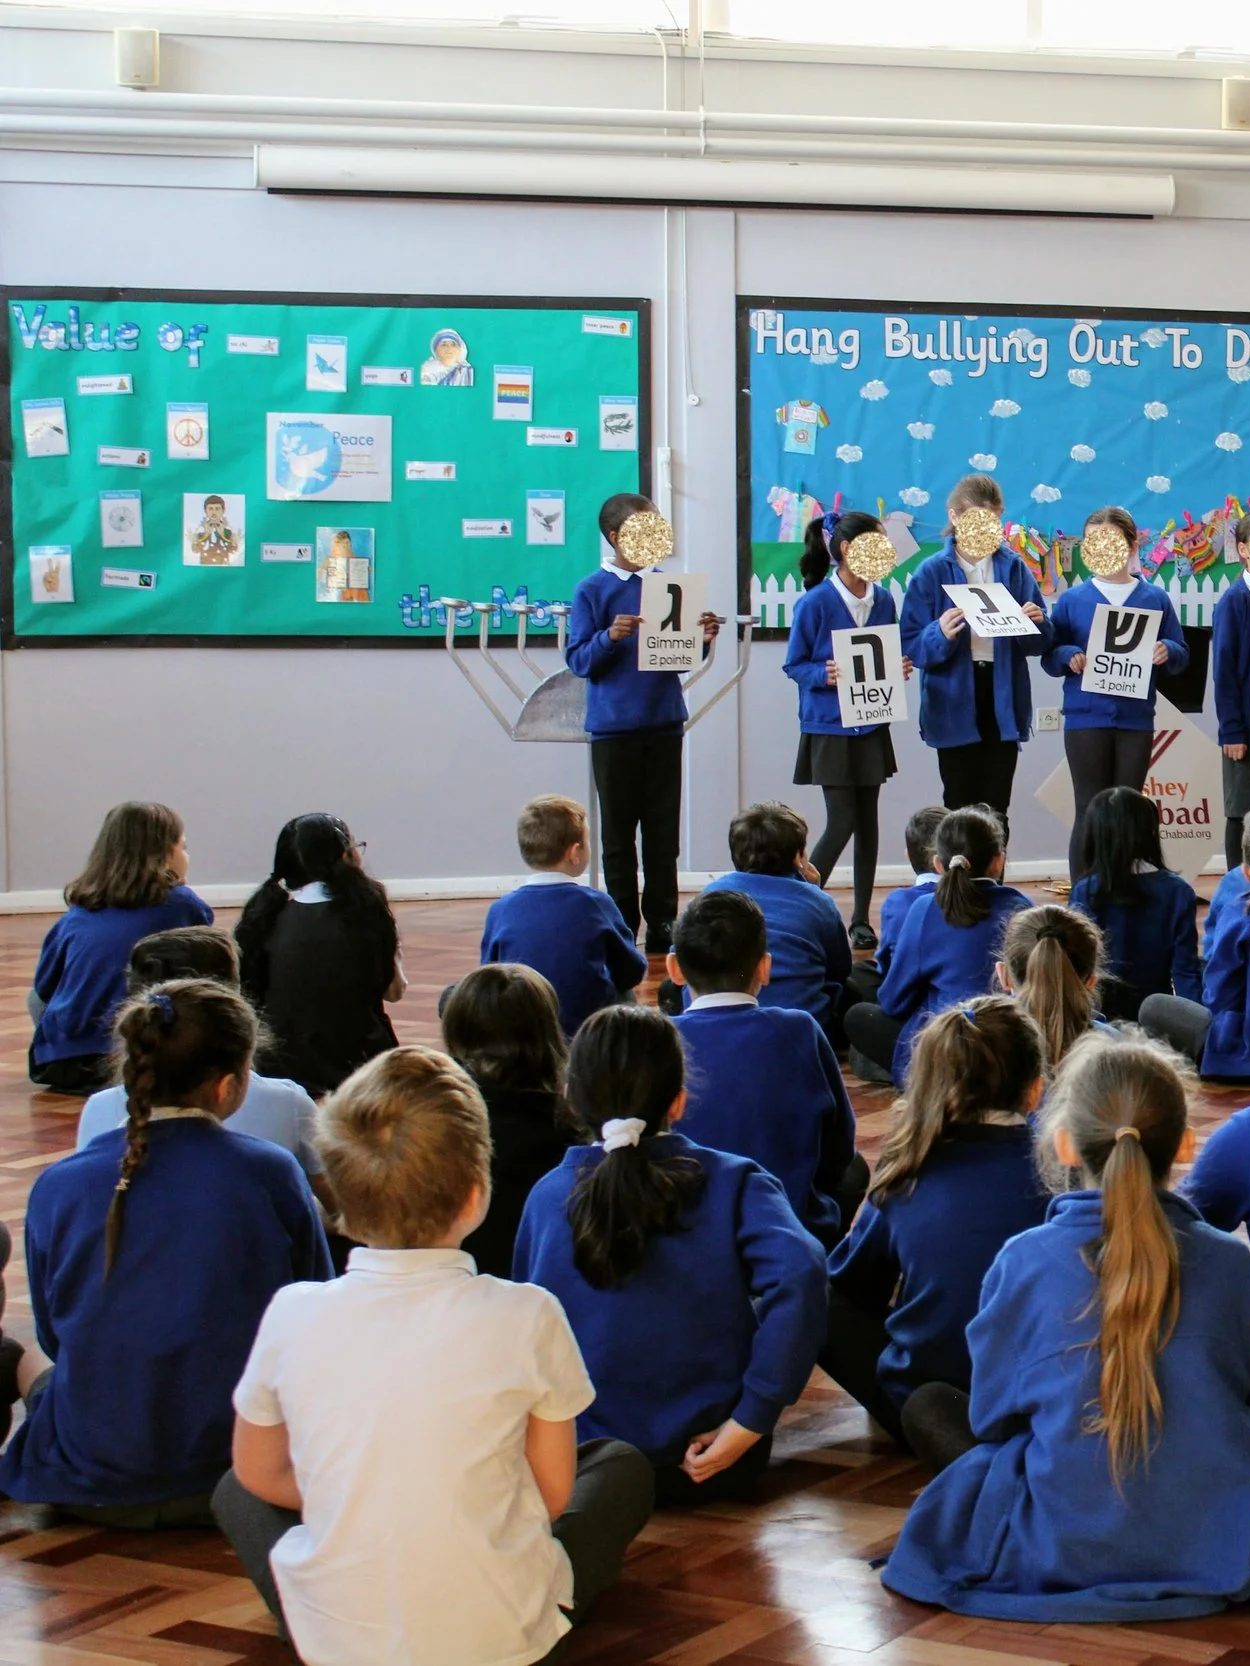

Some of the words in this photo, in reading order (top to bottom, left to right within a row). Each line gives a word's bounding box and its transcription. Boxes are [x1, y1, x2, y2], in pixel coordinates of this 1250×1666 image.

[11, 304, 140, 351] Value
[157, 321, 208, 368] of
[756, 312, 860, 370] Hang
[884, 316, 1048, 378] Bullying
[1068, 322, 1140, 367] Out
[1164, 327, 1203, 369] To
[501, 389, 527, 397] PEACE
[279, 420, 324, 428] November
[332, 431, 375, 446] Peace
[399, 584, 474, 628] the
[661, 583, 683, 632] ג
[968, 587, 1000, 614] נ
[975, 615, 1020, 626] Nun
[986, 626, 1028, 634] Nothing
[646, 636, 695, 649] Gimmel
[1104, 610, 1150, 654] ש
[649, 654, 657, 665] 2
[659, 654, 692, 666] points
[851, 633, 886, 683] ה
[1094, 655, 1142, 679] Shin
[850, 684, 893, 706] Hey
[1095, 679, 1106, 689] -1
[1108, 681, 1136, 693] point
[856, 709, 863, 720] 1
[865, 706, 893, 721] point
[1142, 776, 1189, 802] shey
[1155, 798, 1210, 825] bad
[1159, 829, 1211, 840] Chabad.org
